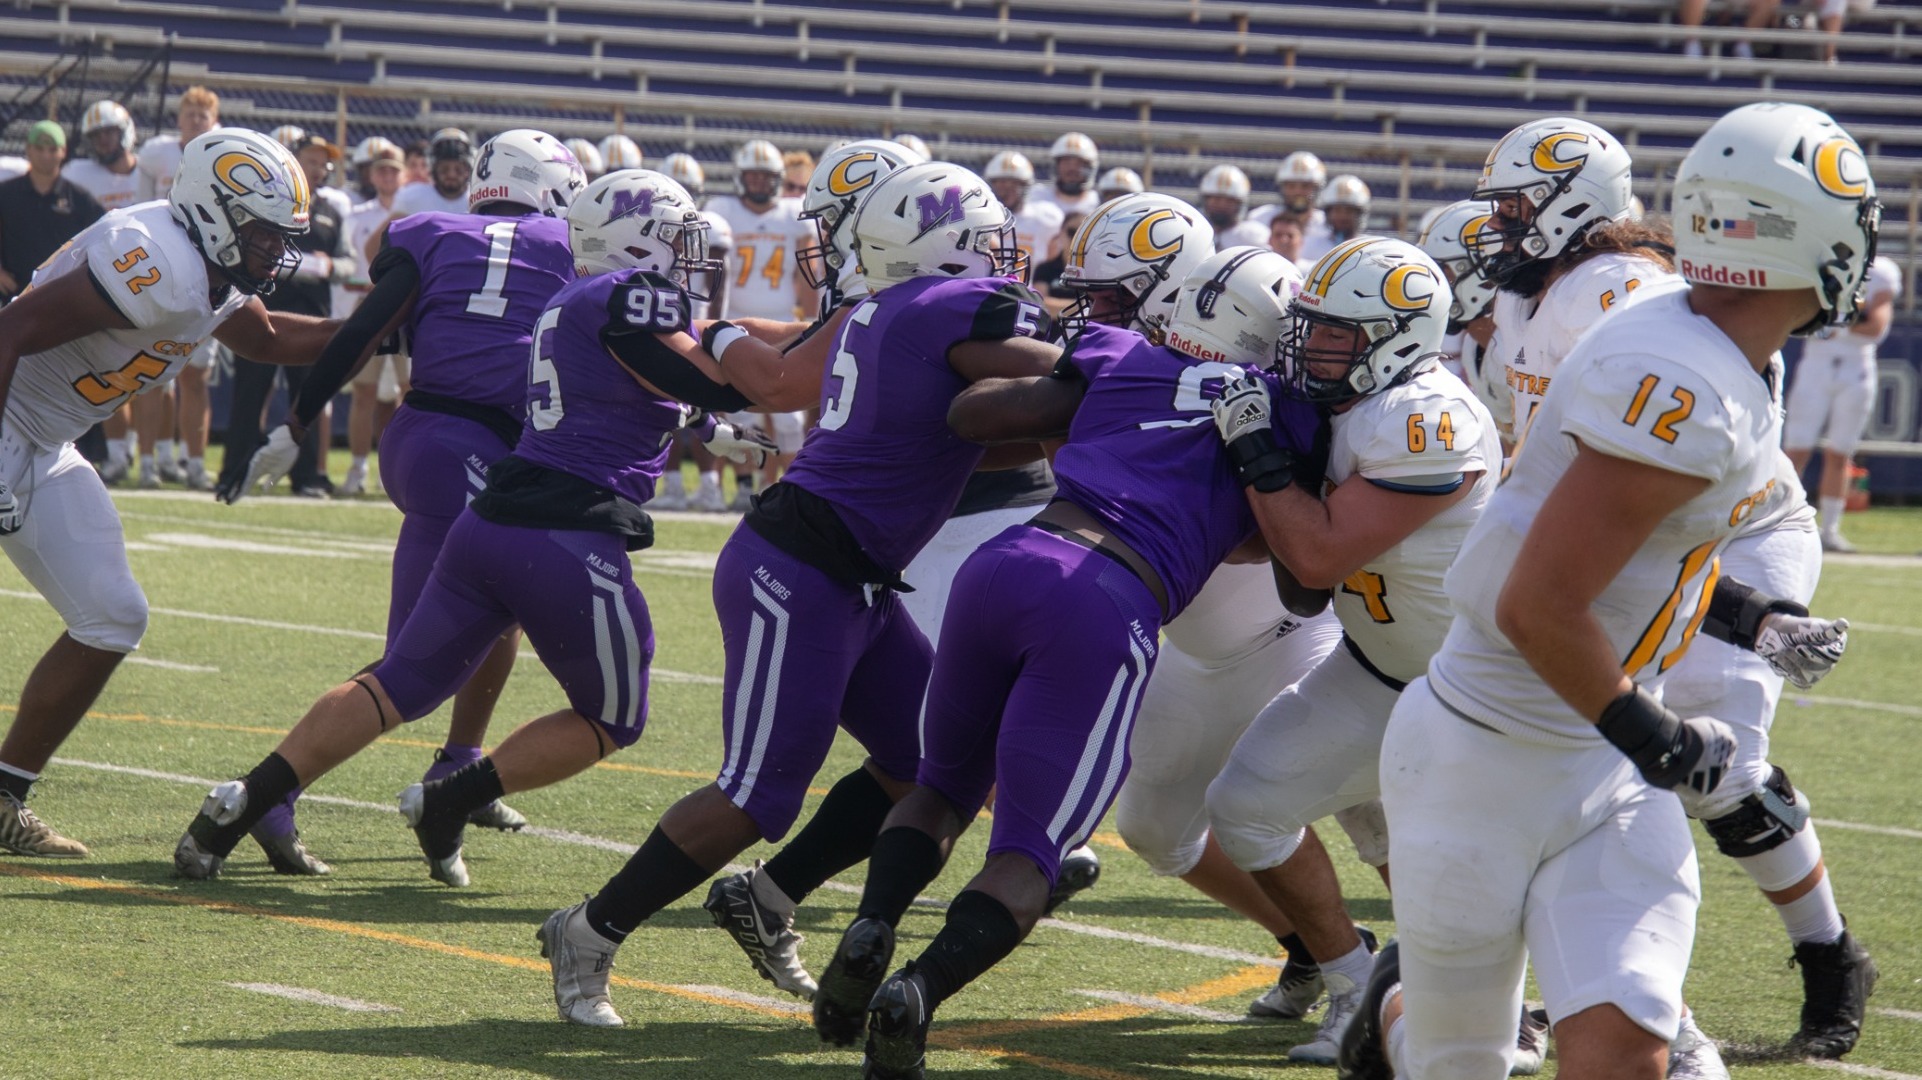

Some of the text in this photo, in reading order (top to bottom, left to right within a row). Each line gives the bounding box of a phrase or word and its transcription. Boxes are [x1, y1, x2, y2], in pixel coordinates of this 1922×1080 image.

[469, 185, 509, 205] Riddell
[1691, 214, 1707, 234] 12
[112, 246, 162, 295] 52
[465, 221, 519, 319] 1
[735, 245, 785, 290] 74
[1681, 258, 1768, 288] Riddell
[625, 287, 681, 328] 95
[1013, 301, 1043, 338] 5
[1170, 331, 1227, 363] Riddell
[1236, 411, 1267, 427] adidas
[1622, 373, 1696, 445] 12
[1406, 411, 1455, 454] 64
[586, 552, 620, 578] MAJORS
[753, 565, 792, 601] MAJORS
[1130, 618, 1156, 659] MAJORS
